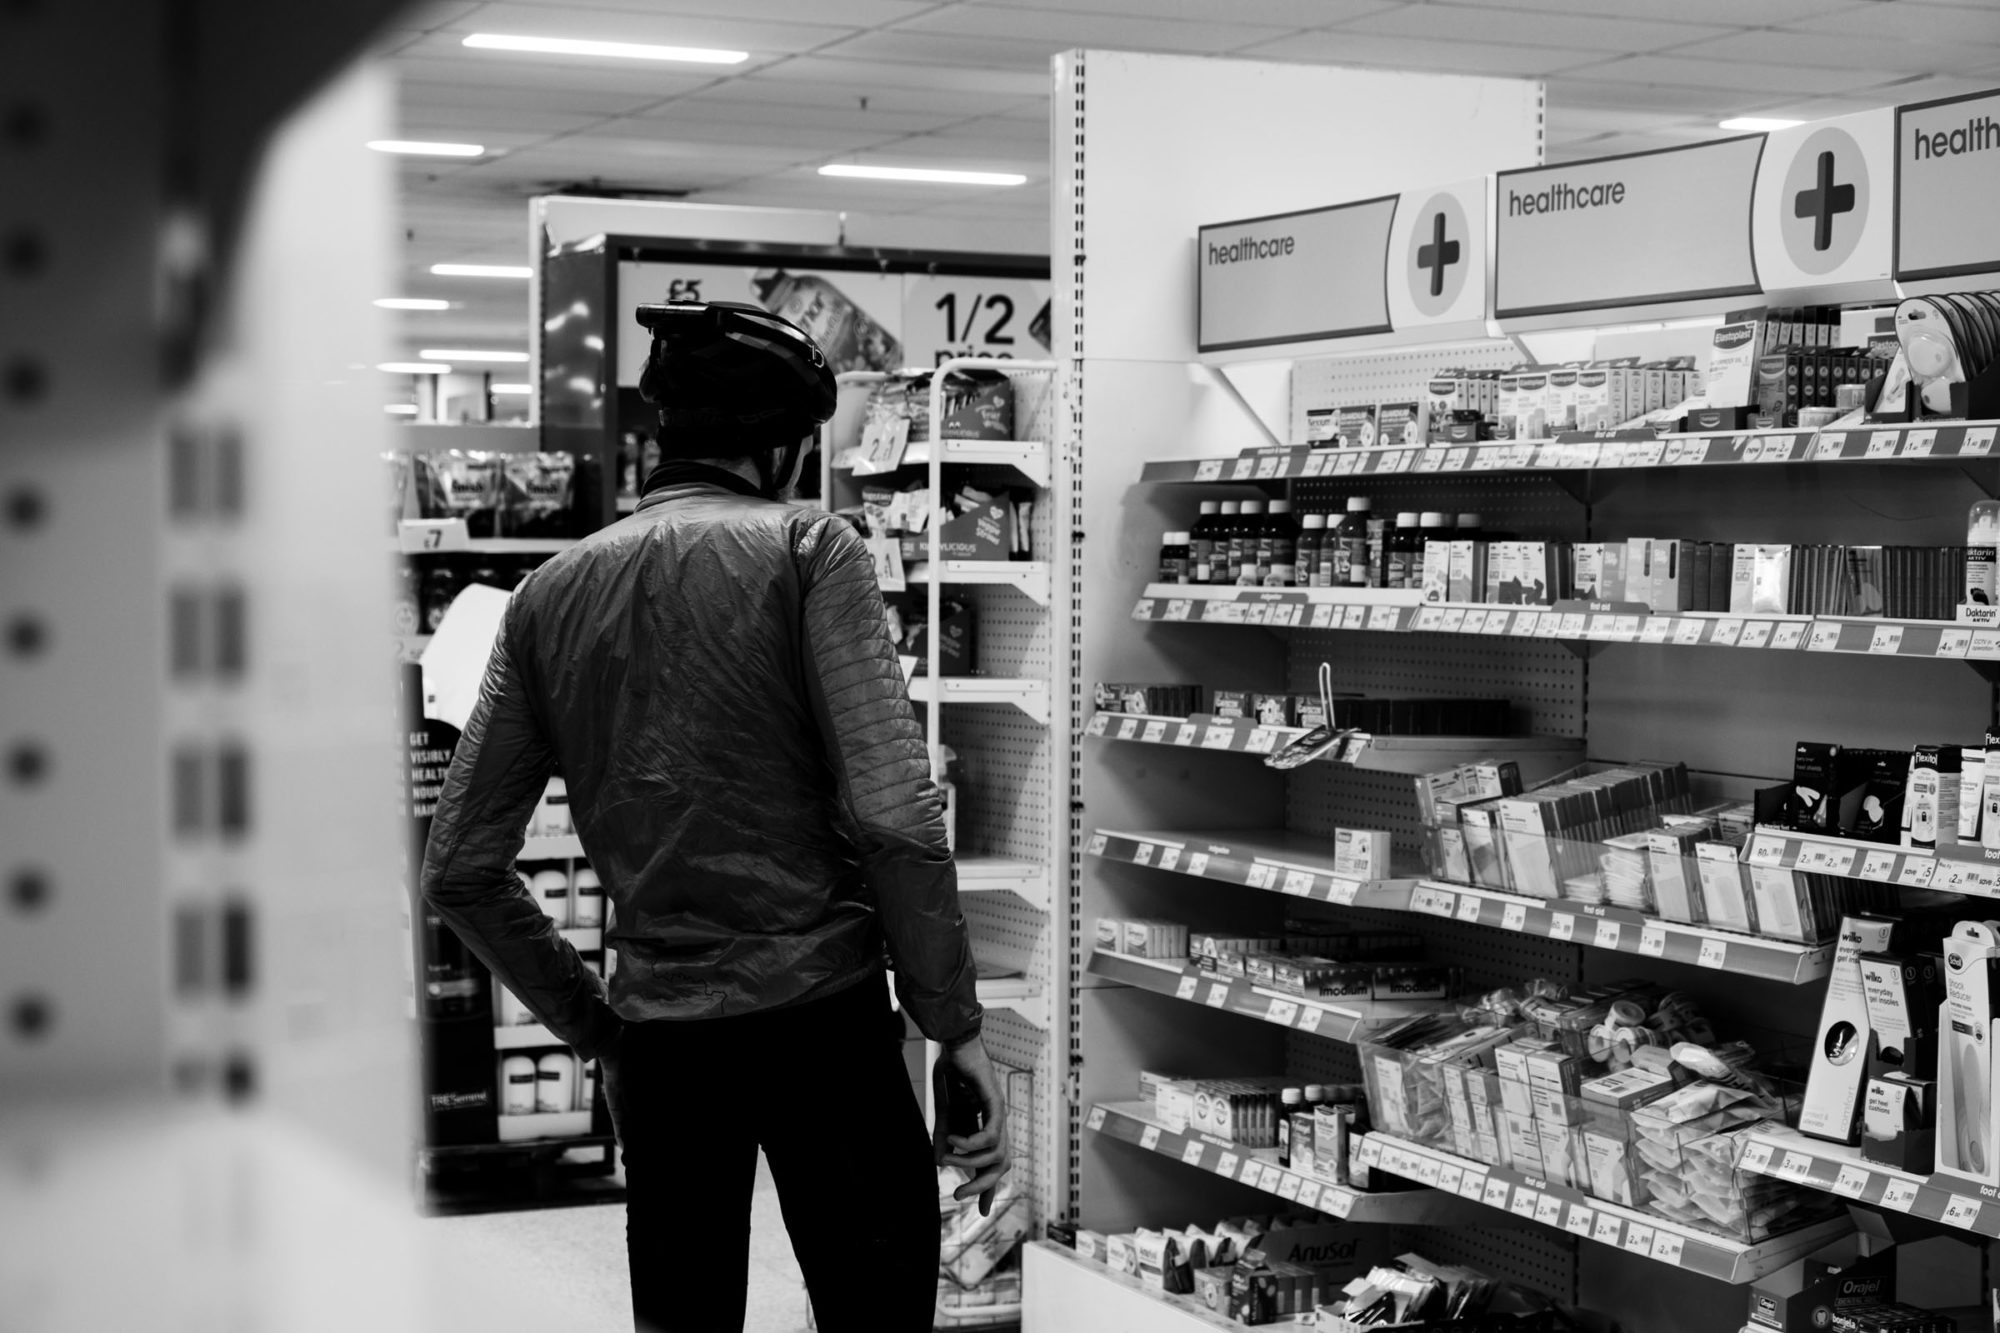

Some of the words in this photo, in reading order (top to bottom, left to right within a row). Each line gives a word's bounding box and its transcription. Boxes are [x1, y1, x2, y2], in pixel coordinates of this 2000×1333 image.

[1510, 182, 1625, 217] healthcare
[1209, 236, 1295, 266] healthcare
[936, 292, 1015, 344] 1/2
[1716, 330, 1753, 345] Elastoplast
[1966, 607, 1997, 618] Daktarin
[410, 732, 429, 746] GET
[410, 750, 451, 764] VISIBLY
[1915, 751, 1938, 766] Flexitol
[1842, 932, 1863, 944] wilko
[1864, 971, 1883, 984] wilko
[1320, 983, 1368, 996] Imodium
[1868, 987, 1894, 998] everyday
[1879, 997, 1900, 1007] insoles
[1871, 1087, 1884, 1096] wilko
[1868, 1098, 1878, 1106] gel
[1840, 1085, 1856, 1134] comfort
[1868, 1105, 1890, 1114] cushions
[1980, 1185, 1996, 1198] foot
[1843, 1281, 1881, 1297] Orajel
[1833, 1314, 1857, 1329] bonjela
